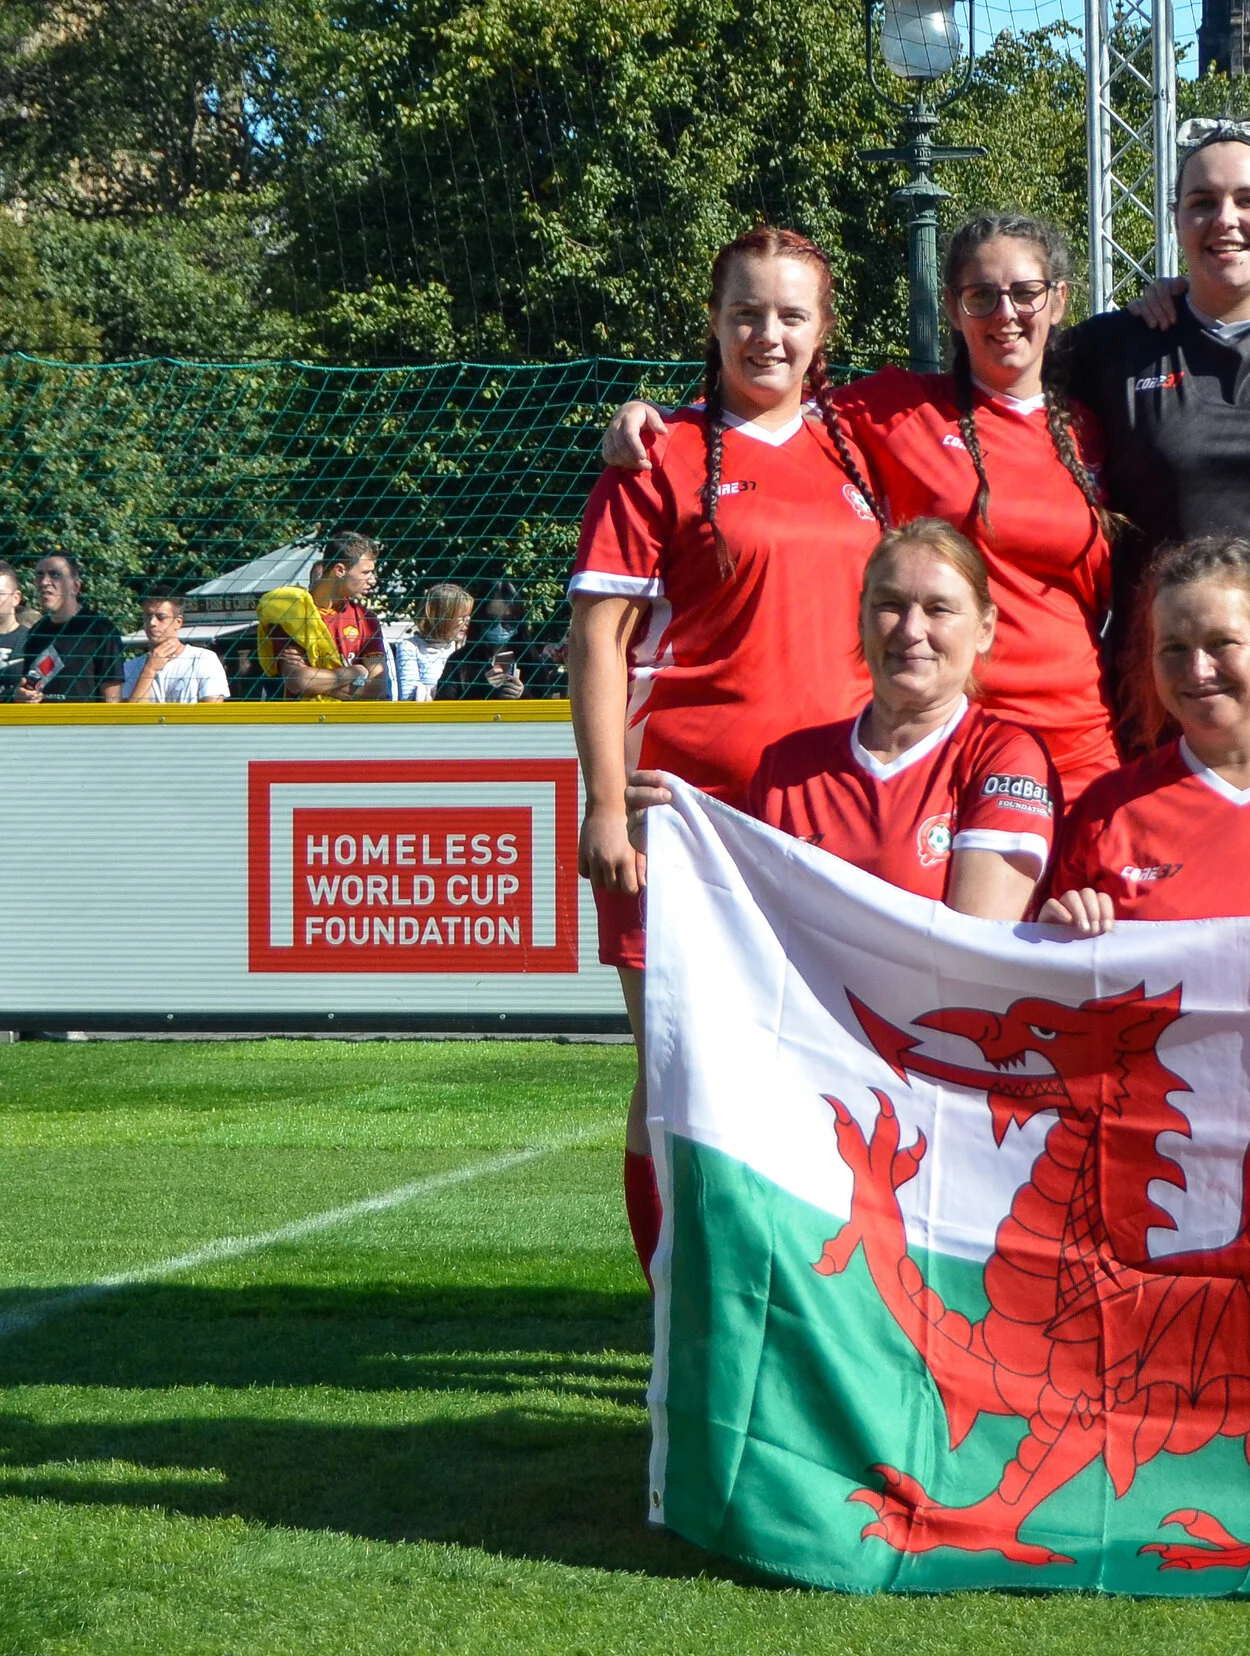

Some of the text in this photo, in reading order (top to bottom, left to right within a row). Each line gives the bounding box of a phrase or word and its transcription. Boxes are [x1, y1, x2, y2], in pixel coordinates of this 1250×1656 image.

[306, 834, 519, 865] HOMELESS
[1121, 864, 1184, 881] CORE37
[306, 874, 519, 906] WORLD CUP
[305, 916, 520, 945] FOUNDATION
